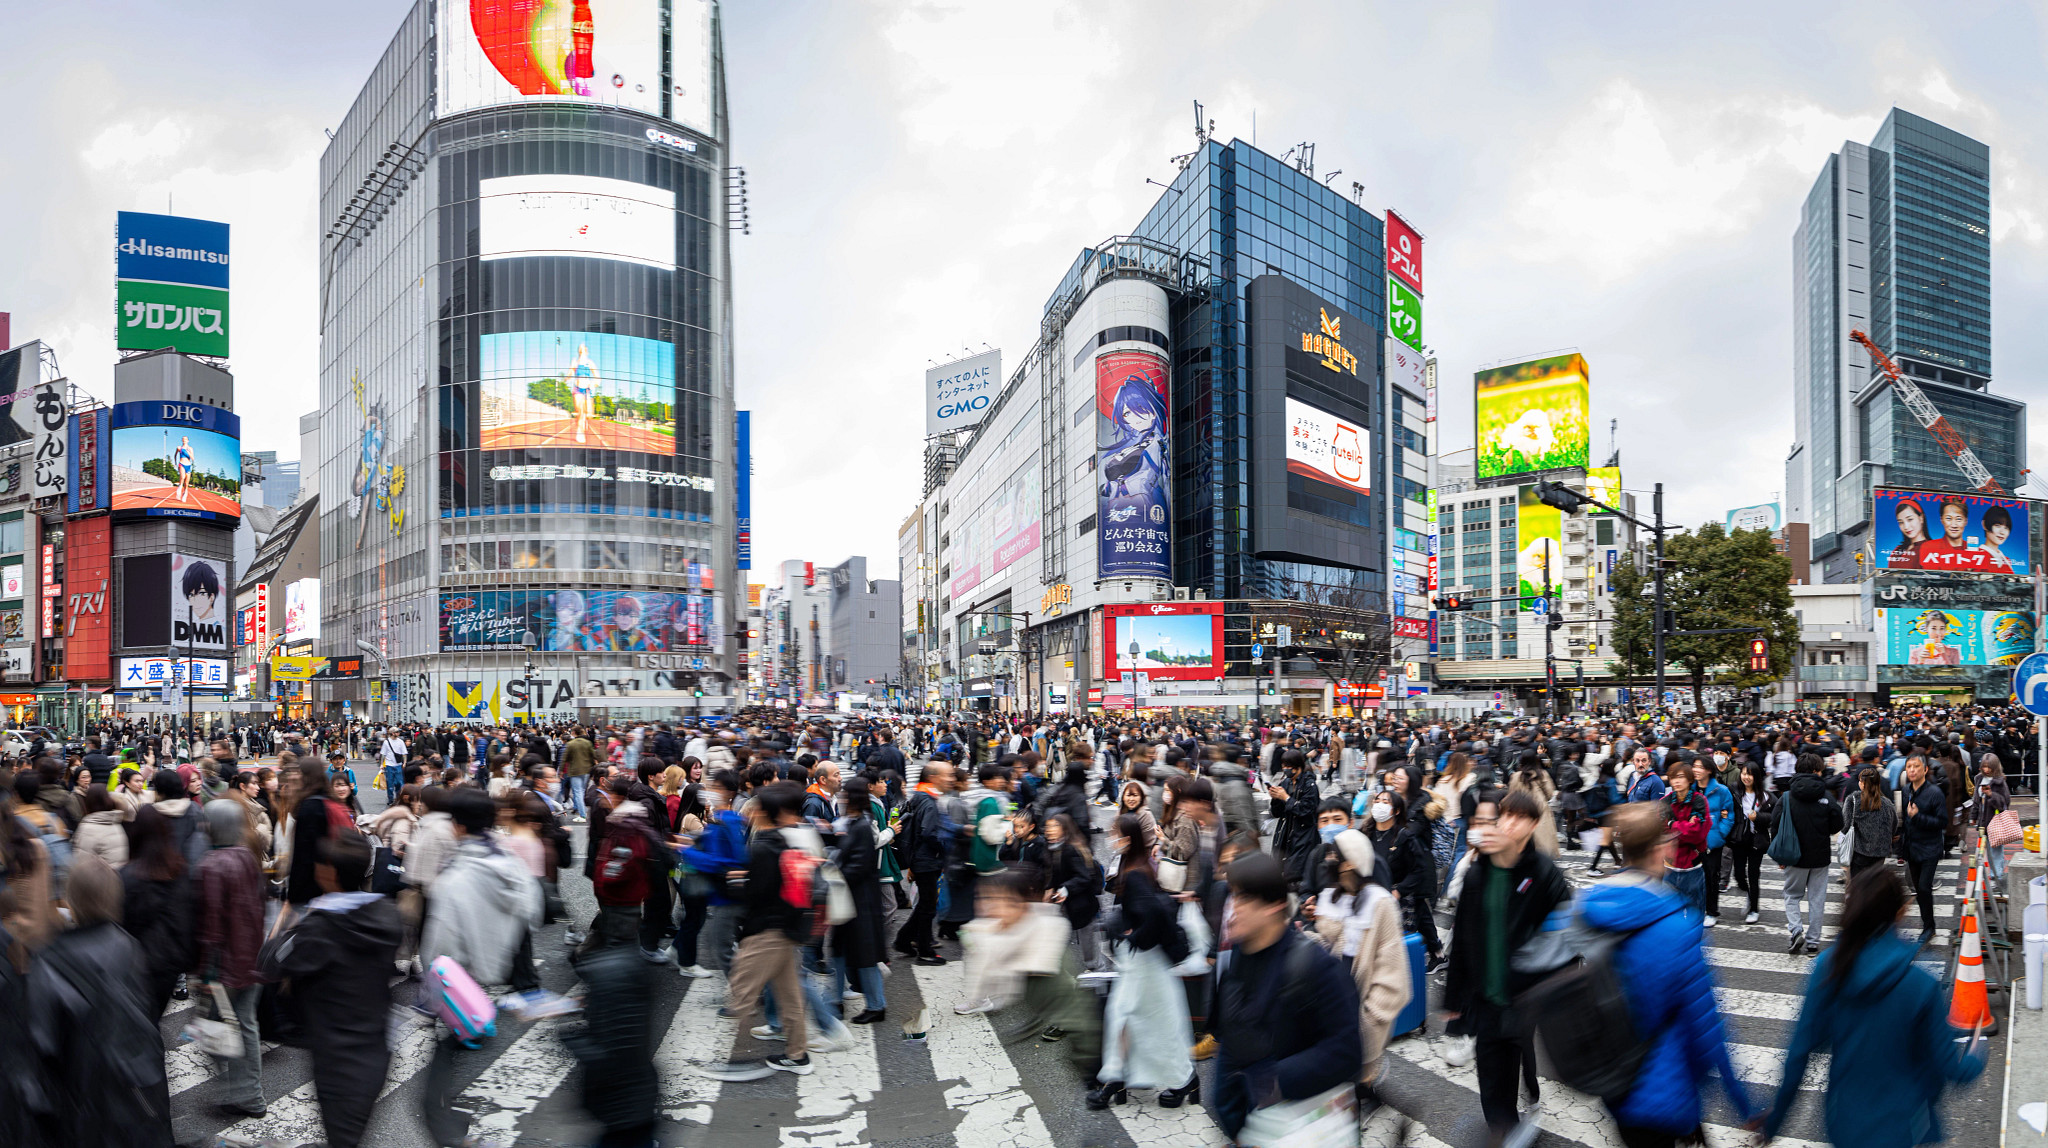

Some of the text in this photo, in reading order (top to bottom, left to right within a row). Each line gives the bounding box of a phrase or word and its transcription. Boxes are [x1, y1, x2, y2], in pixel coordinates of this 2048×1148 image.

[119, 238, 229, 265] Hisamitsu
[1390, 246, 1420, 283] アコム
[124, 301, 224, 336] サロンパス
[1302, 332, 1358, 376] MAGNET
[936, 366, 990, 389] すべての人に
[936, 379, 990, 401] インターネット
[162, 404, 203, 422] DHC
[937, 395, 990, 418] GMO
[35, 384, 65, 492] もんじゃ
[1331, 445, 1363, 465] nutella
[1104, 527, 1169, 543] どんな宇宙でも
[1115, 541, 1162, 553] 巡り会える
[1923, 552, 1985, 566] ペイトク
[1881, 585, 1908, 600] JR
[1910, 586, 1955, 601] 渋谷駅
[68, 578, 109, 637] クスリ
[447, 608, 495, 626] にじさんじ
[1151, 605, 1176, 615] Glico
[174, 620, 224, 645] DMM
[486, 627, 526, 640] デビュー
[1968, 613, 1977, 662] キリンビール
[128, 662, 220, 682] 大盛堂書店
[637, 654, 713, 671] TSUTAA
